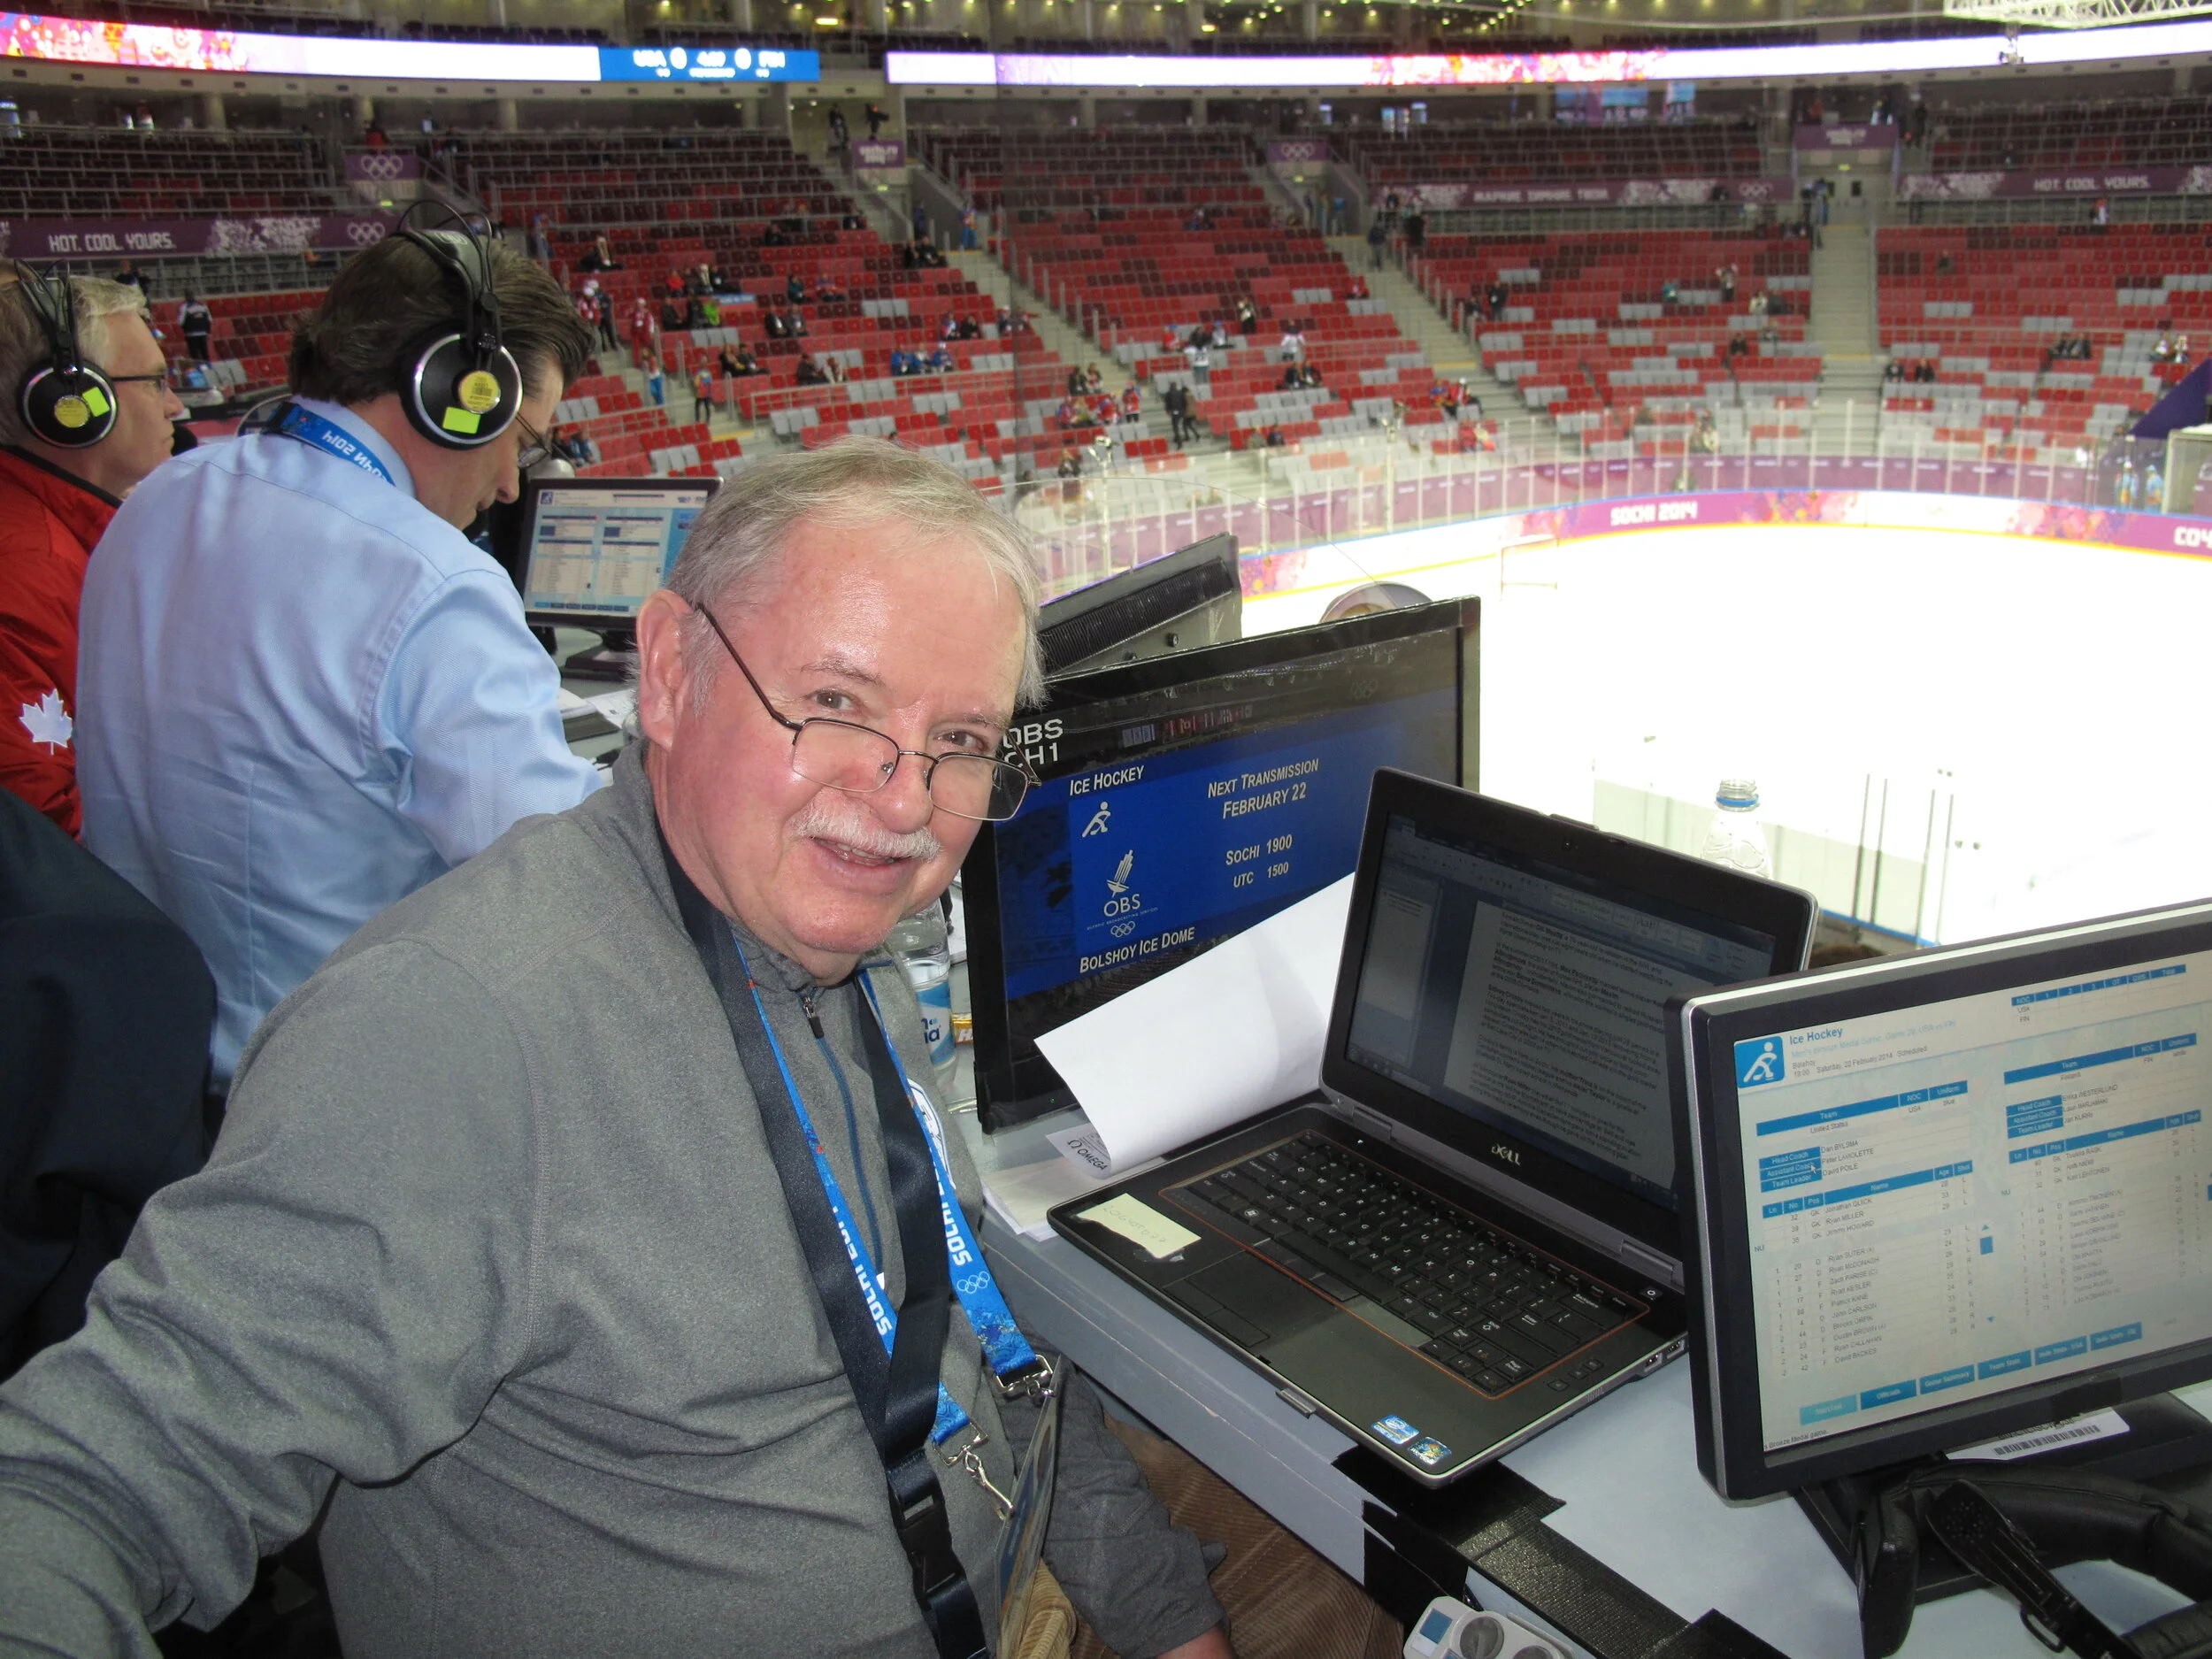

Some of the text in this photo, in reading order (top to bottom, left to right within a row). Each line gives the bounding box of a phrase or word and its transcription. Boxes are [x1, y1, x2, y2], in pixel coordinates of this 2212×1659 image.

[48, 234, 82, 252] HOT.
[125, 232, 176, 250] YOURS.
[322, 430, 357, 456] 2014
[1610, 501, 1697, 526] SOCHI 2014
[1003, 718, 1063, 749] OBS
[1070, 765, 1144, 796] ICE HOCKEY
[1208, 758, 1318, 798] NEXT TRANSMISSION
[1223, 781, 1307, 819] FEBRUARY 22
[1225, 833, 1293, 865] SOCHI 1900
[1233, 861, 1289, 888] UTC 1500
[1103, 894, 1141, 917] OBS
[1079, 926, 1195, 973] BOLSHOY ICE DOME
[1790, 1027, 1844, 1045] Ice Hockey
[1820, 1111, 1838, 1120] Team
[1810, 1120, 1848, 1134] United States
[1491, 1143, 1520, 1166] DELL
[1821, 1140, 1859, 1154] Dan BYLSMA
[1077, 1148, 1108, 1171] OMEGA
[1771, 1151, 1809, 1164] Head Coach
[1821, 1148, 1874, 1164] Peter LAVIOLETTE
[1767, 1166, 1795, 1178] Assistant
[1823, 1163, 1858, 1177] David POILE
[1772, 1173, 1812, 1187] Team Leader
[1852, 1199, 1872, 1208] QUICK
[1826, 1210, 1864, 1225] Ryan MILLER
[1847, 1220, 1874, 1232] HOWARD
[1828, 1248, 1865, 1262] Ryan SUTER
[1829, 1264, 1844, 1273] Ryan
[1770, 1438, 1790, 1448] Bronze
[1791, 1432, 1809, 1443] Medal
